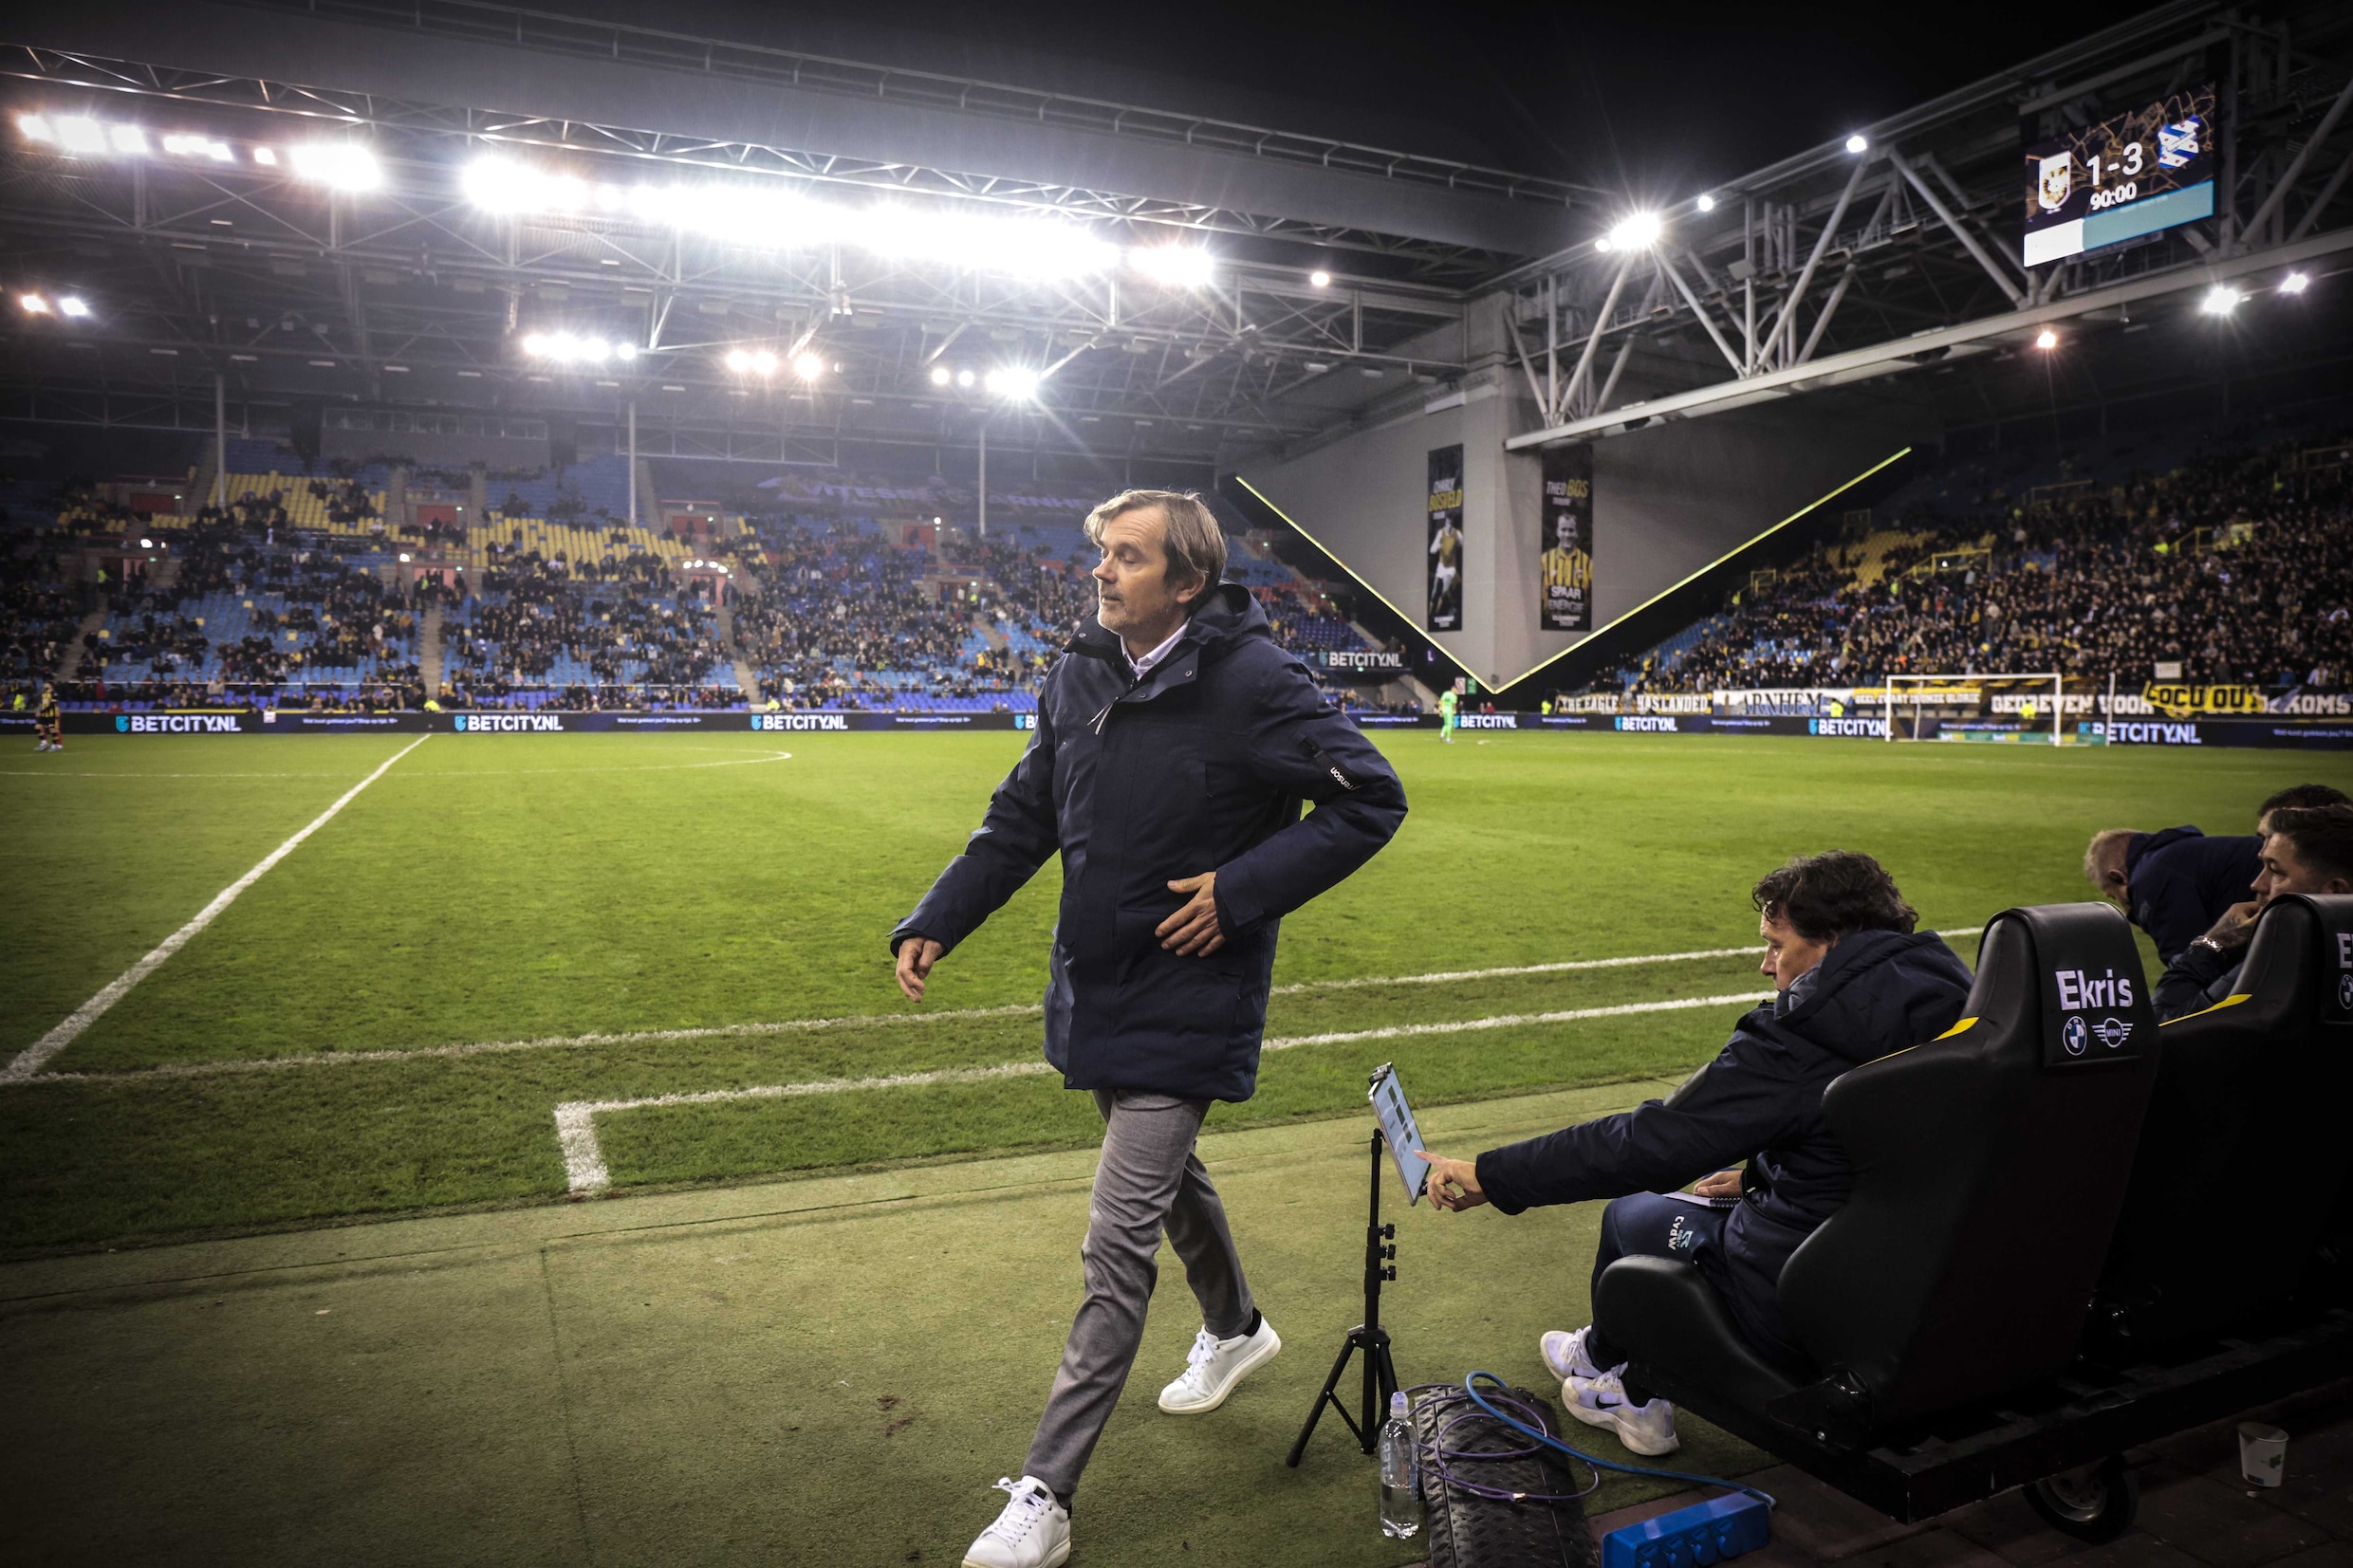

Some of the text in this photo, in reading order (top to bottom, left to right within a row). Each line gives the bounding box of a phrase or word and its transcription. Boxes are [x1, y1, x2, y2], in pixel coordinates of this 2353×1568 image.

[2086, 155, 2100, 186] 1
[2122, 142, 2143, 175] 3
[2090, 182, 2137, 211] 90:00
[1566, 479, 1589, 498] BOS
[1551, 585, 1581, 600] SPAAR
[1329, 652, 1402, 667] BETCITY.NL
[1562, 696, 1582, 711] THE
[1584, 695, 1619, 711] EAGLE
[1661, 694, 1708, 712] LANDED
[131, 715, 241, 732] BETCITY.NL
[468, 715, 564, 730] BETCITY.NL
[763, 714, 847, 729] BETCITY.NL
[1460, 715, 1516, 729] BETCITY.NL
[1622, 716, 1677, 731] BETCITY.NL
[2055, 968, 2134, 1011] Ekris
[2105, 1028, 2121, 1038] MINI
